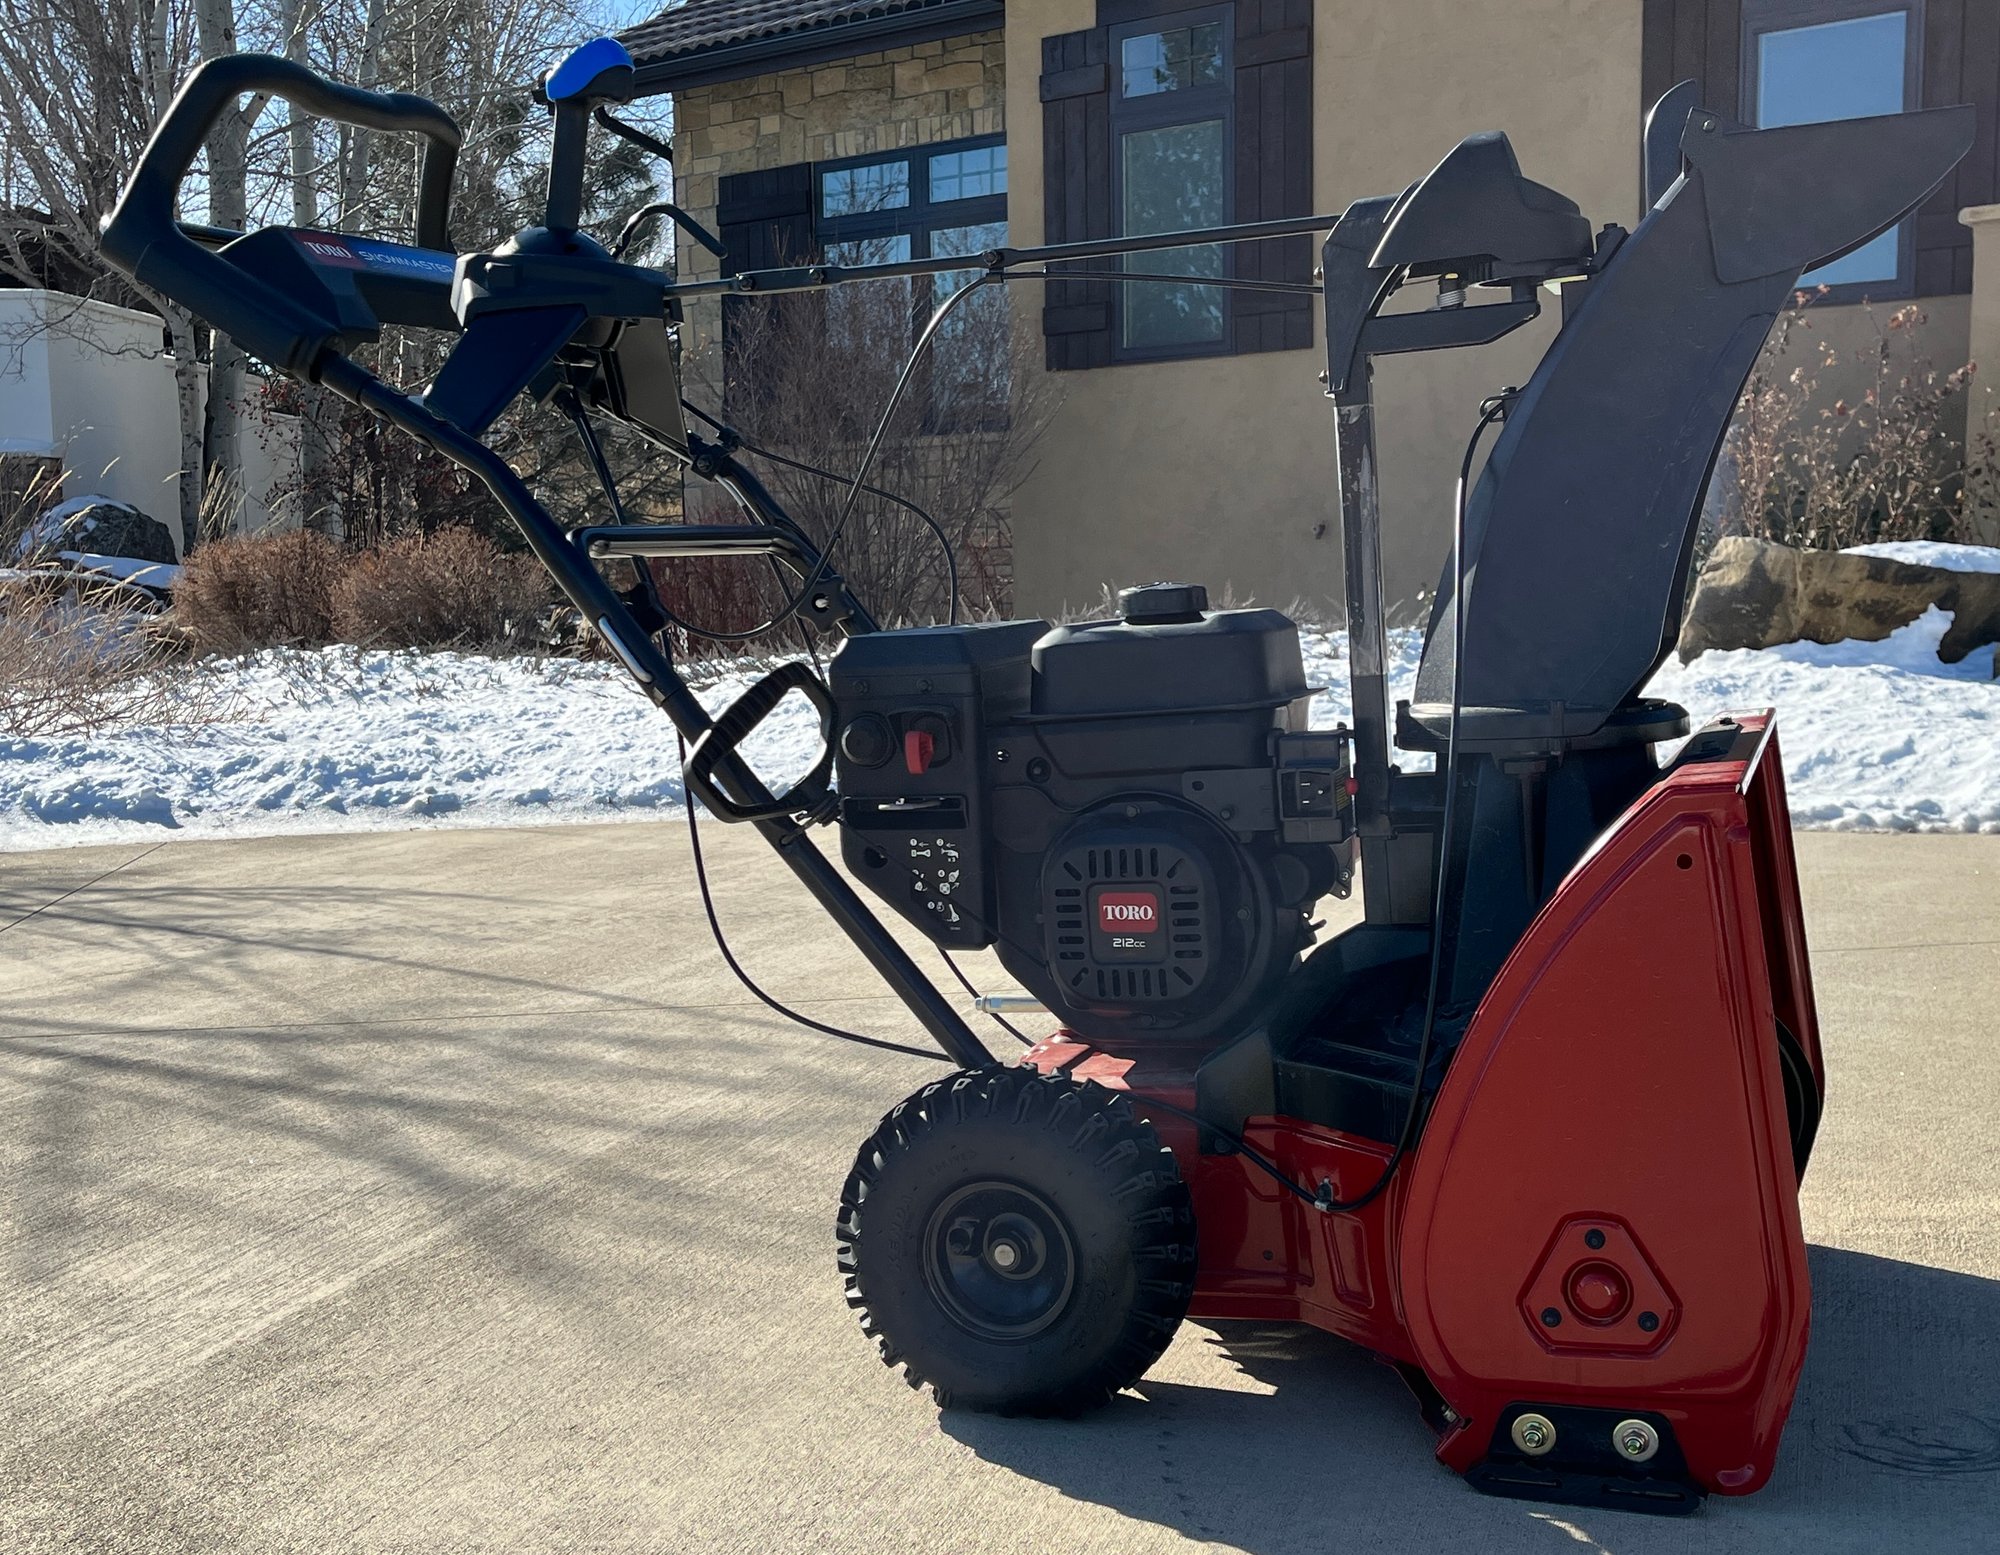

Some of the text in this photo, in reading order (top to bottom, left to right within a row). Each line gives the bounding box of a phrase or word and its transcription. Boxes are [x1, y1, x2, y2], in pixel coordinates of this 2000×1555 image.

[304, 241, 353, 259] TORO
[1103, 905, 1154, 920] TORO
[1112, 938, 1146, 948] 212cc
